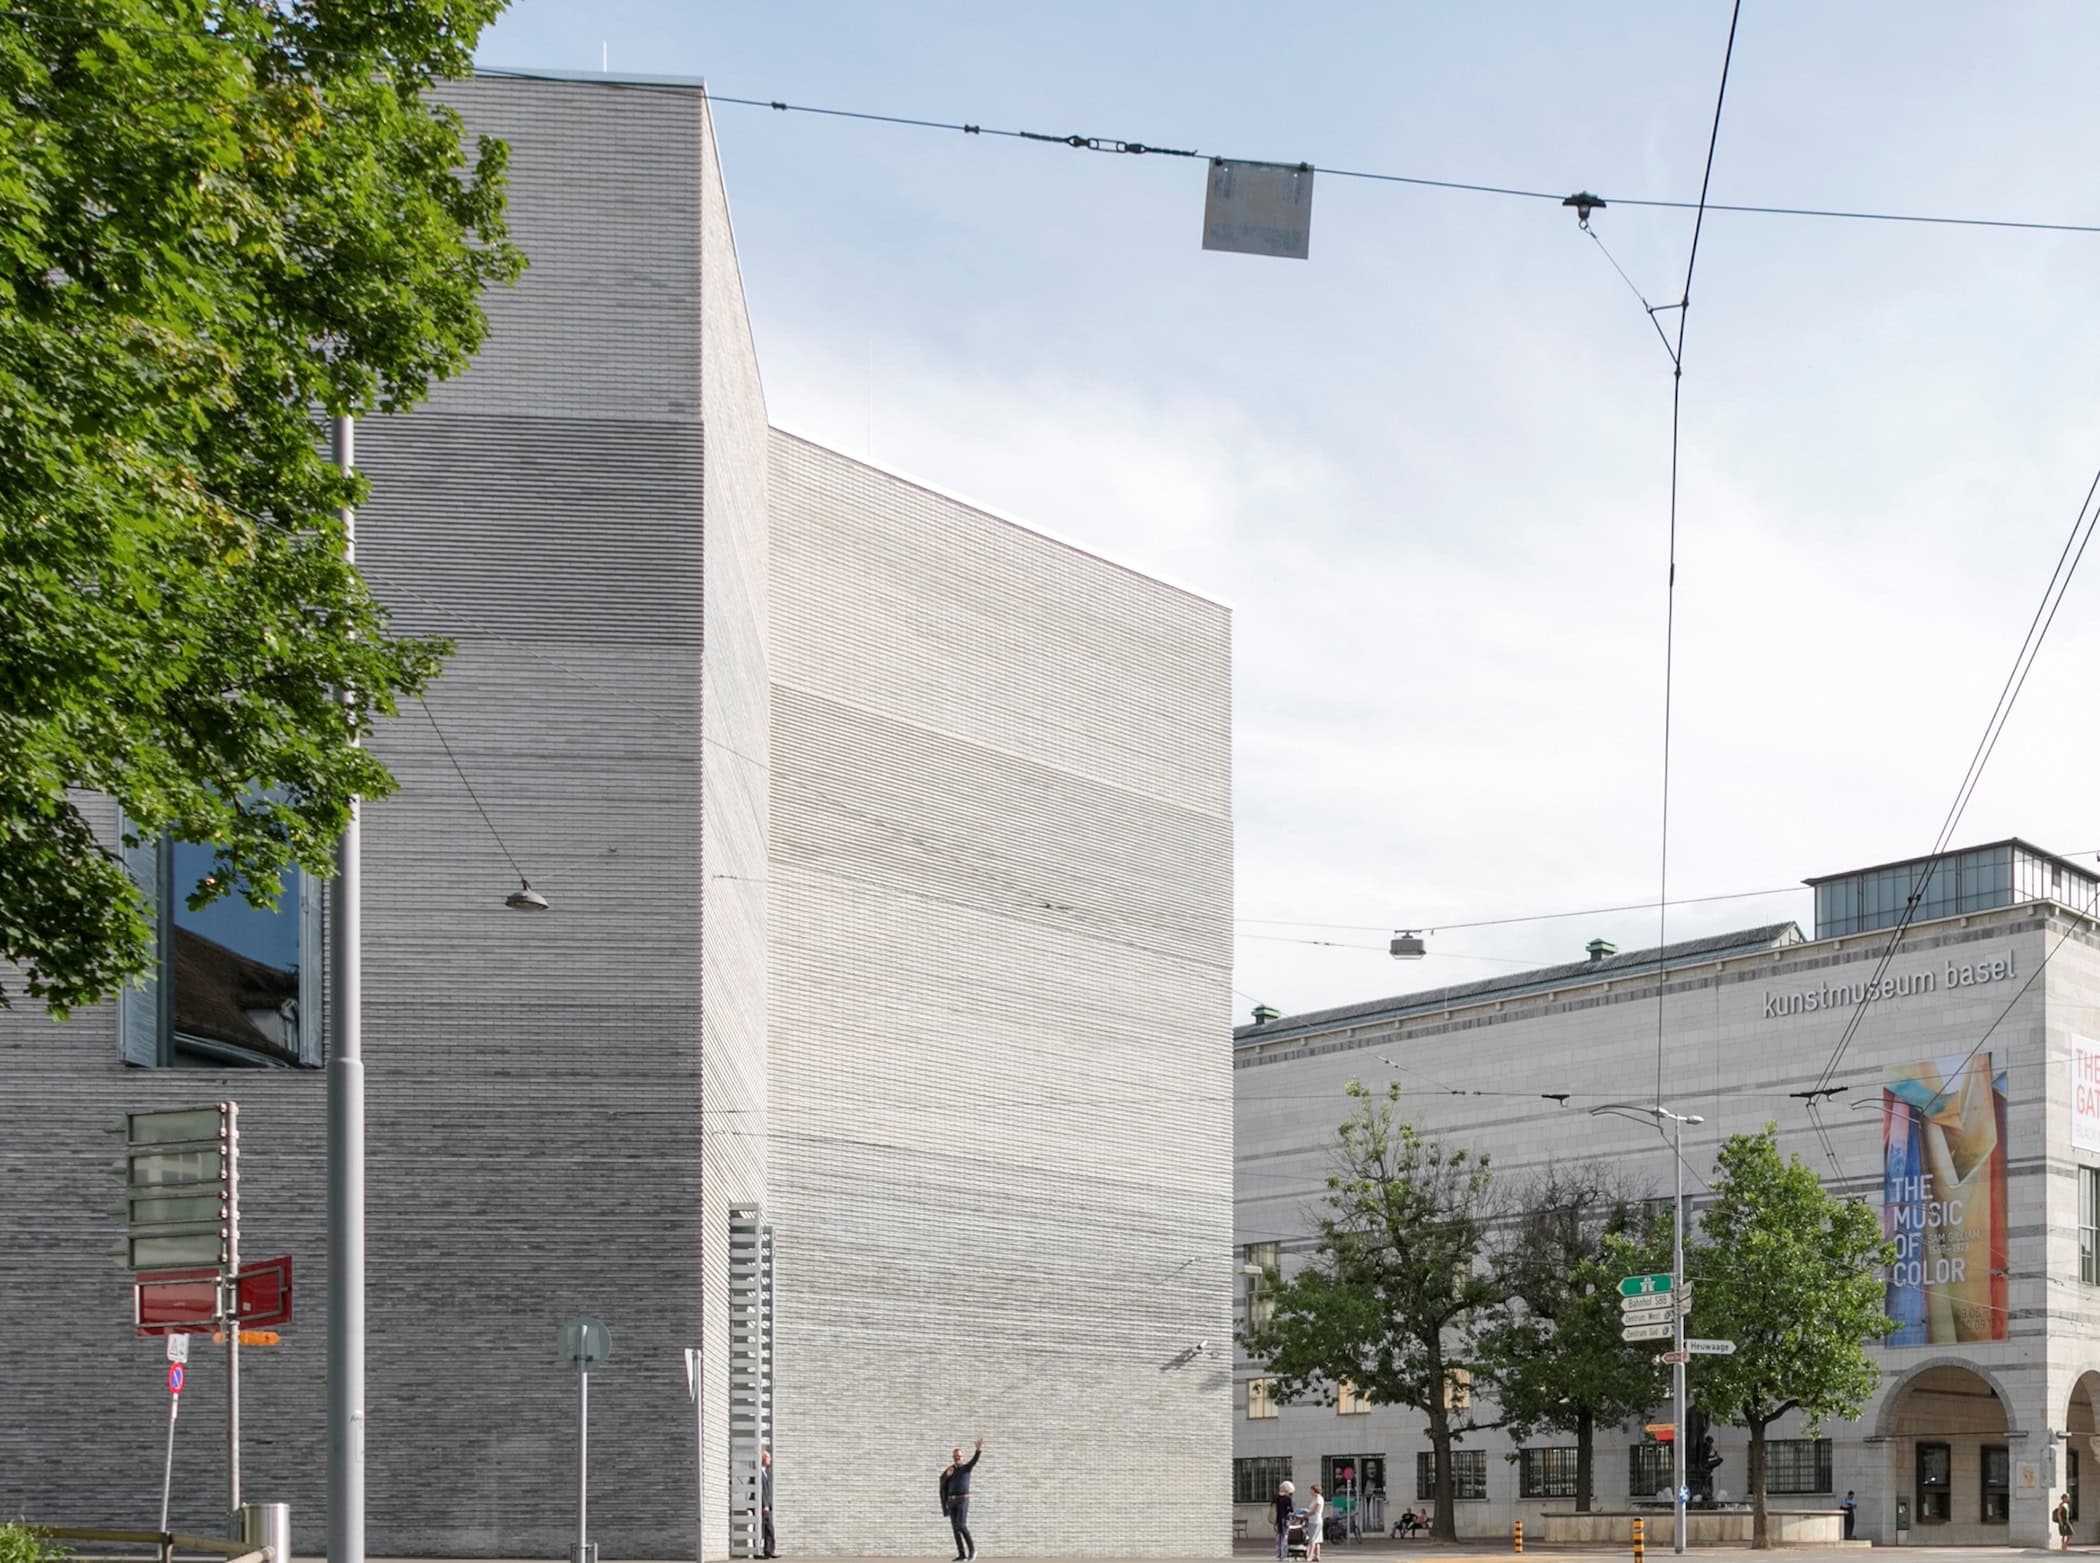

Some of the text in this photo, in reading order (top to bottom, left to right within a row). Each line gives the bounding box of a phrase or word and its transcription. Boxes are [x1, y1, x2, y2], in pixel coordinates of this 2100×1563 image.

[1762, 949, 2016, 1018] kunstmuseum basel
[1891, 1174, 1934, 1202] THE
[1893, 1200, 1963, 1231] MUSIC
[1894, 1232, 1922, 1260] OF
[1893, 1257, 1965, 1288] COLOR
[1628, 1294, 1667, 1309] Bahnhof SBB
[1690, 1341, 1729, 1352] Heuwaage
